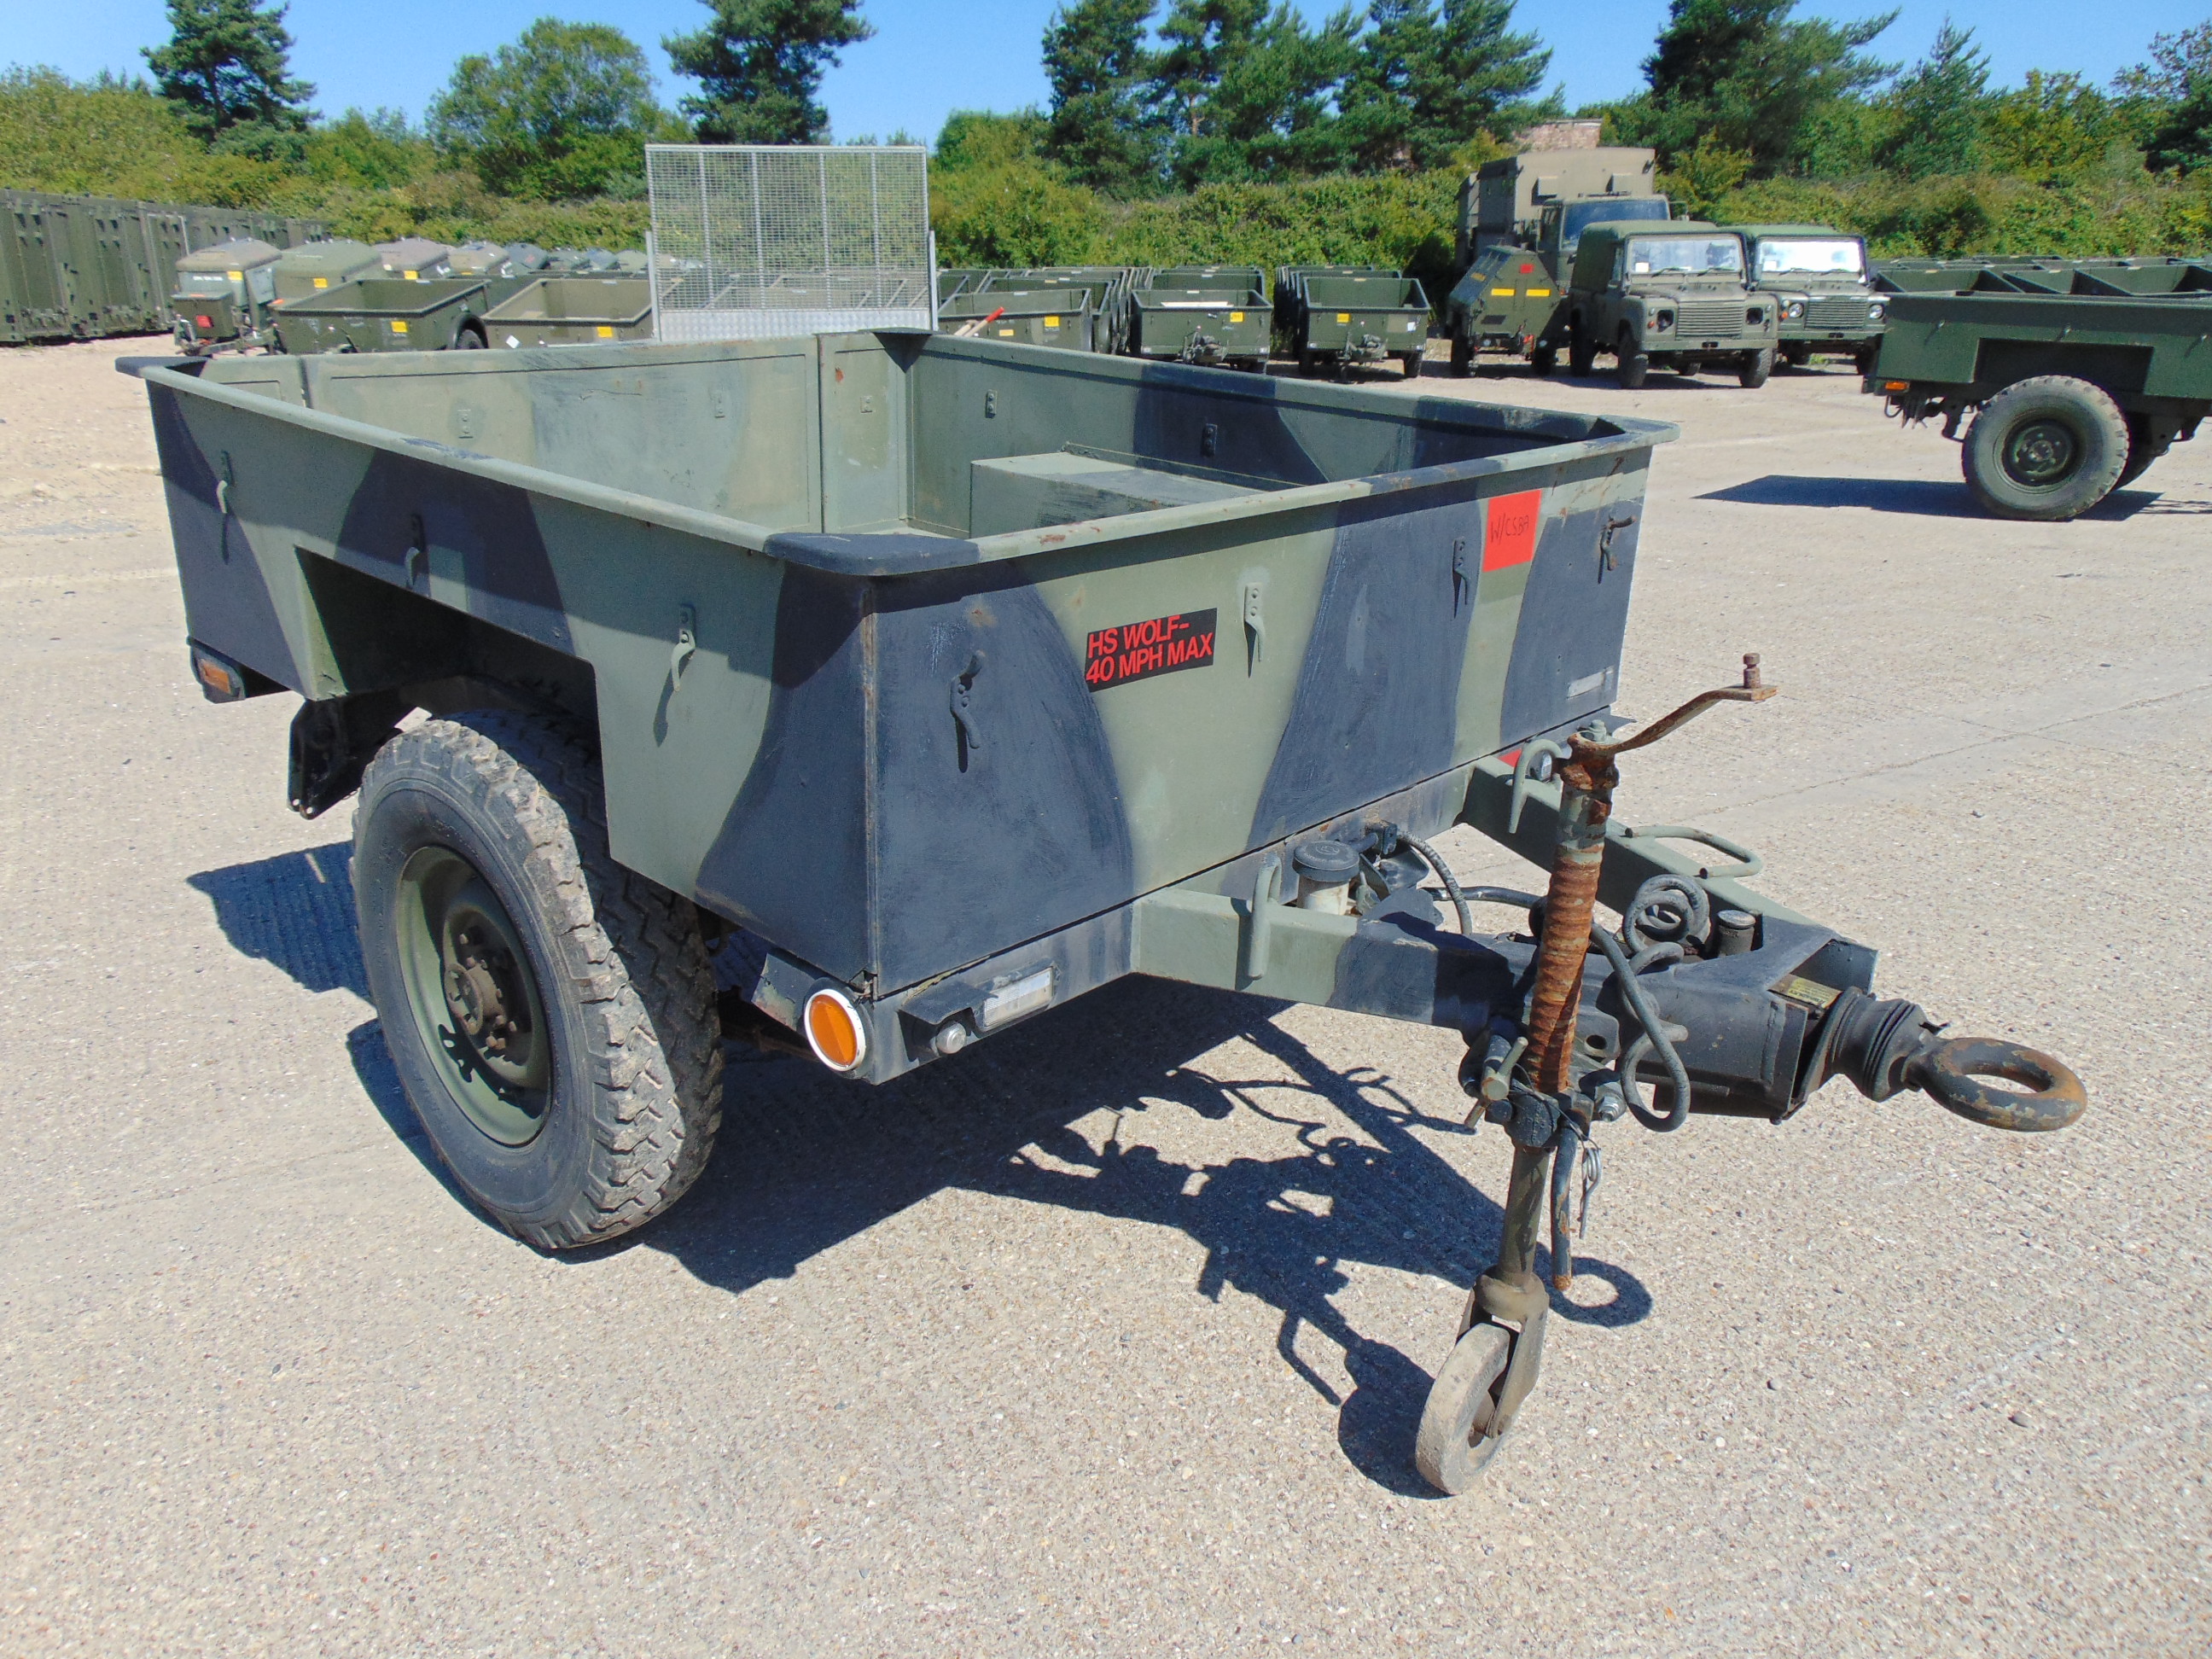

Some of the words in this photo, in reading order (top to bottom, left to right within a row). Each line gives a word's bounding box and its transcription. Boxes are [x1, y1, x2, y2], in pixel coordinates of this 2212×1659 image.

[1086, 655, 1115, 684] 40
[1119, 644, 1164, 678] MPH
[1167, 632, 1214, 666] MAX
[1088, 627, 1119, 659] HS
[1123, 614, 1190, 649] WOLF-
